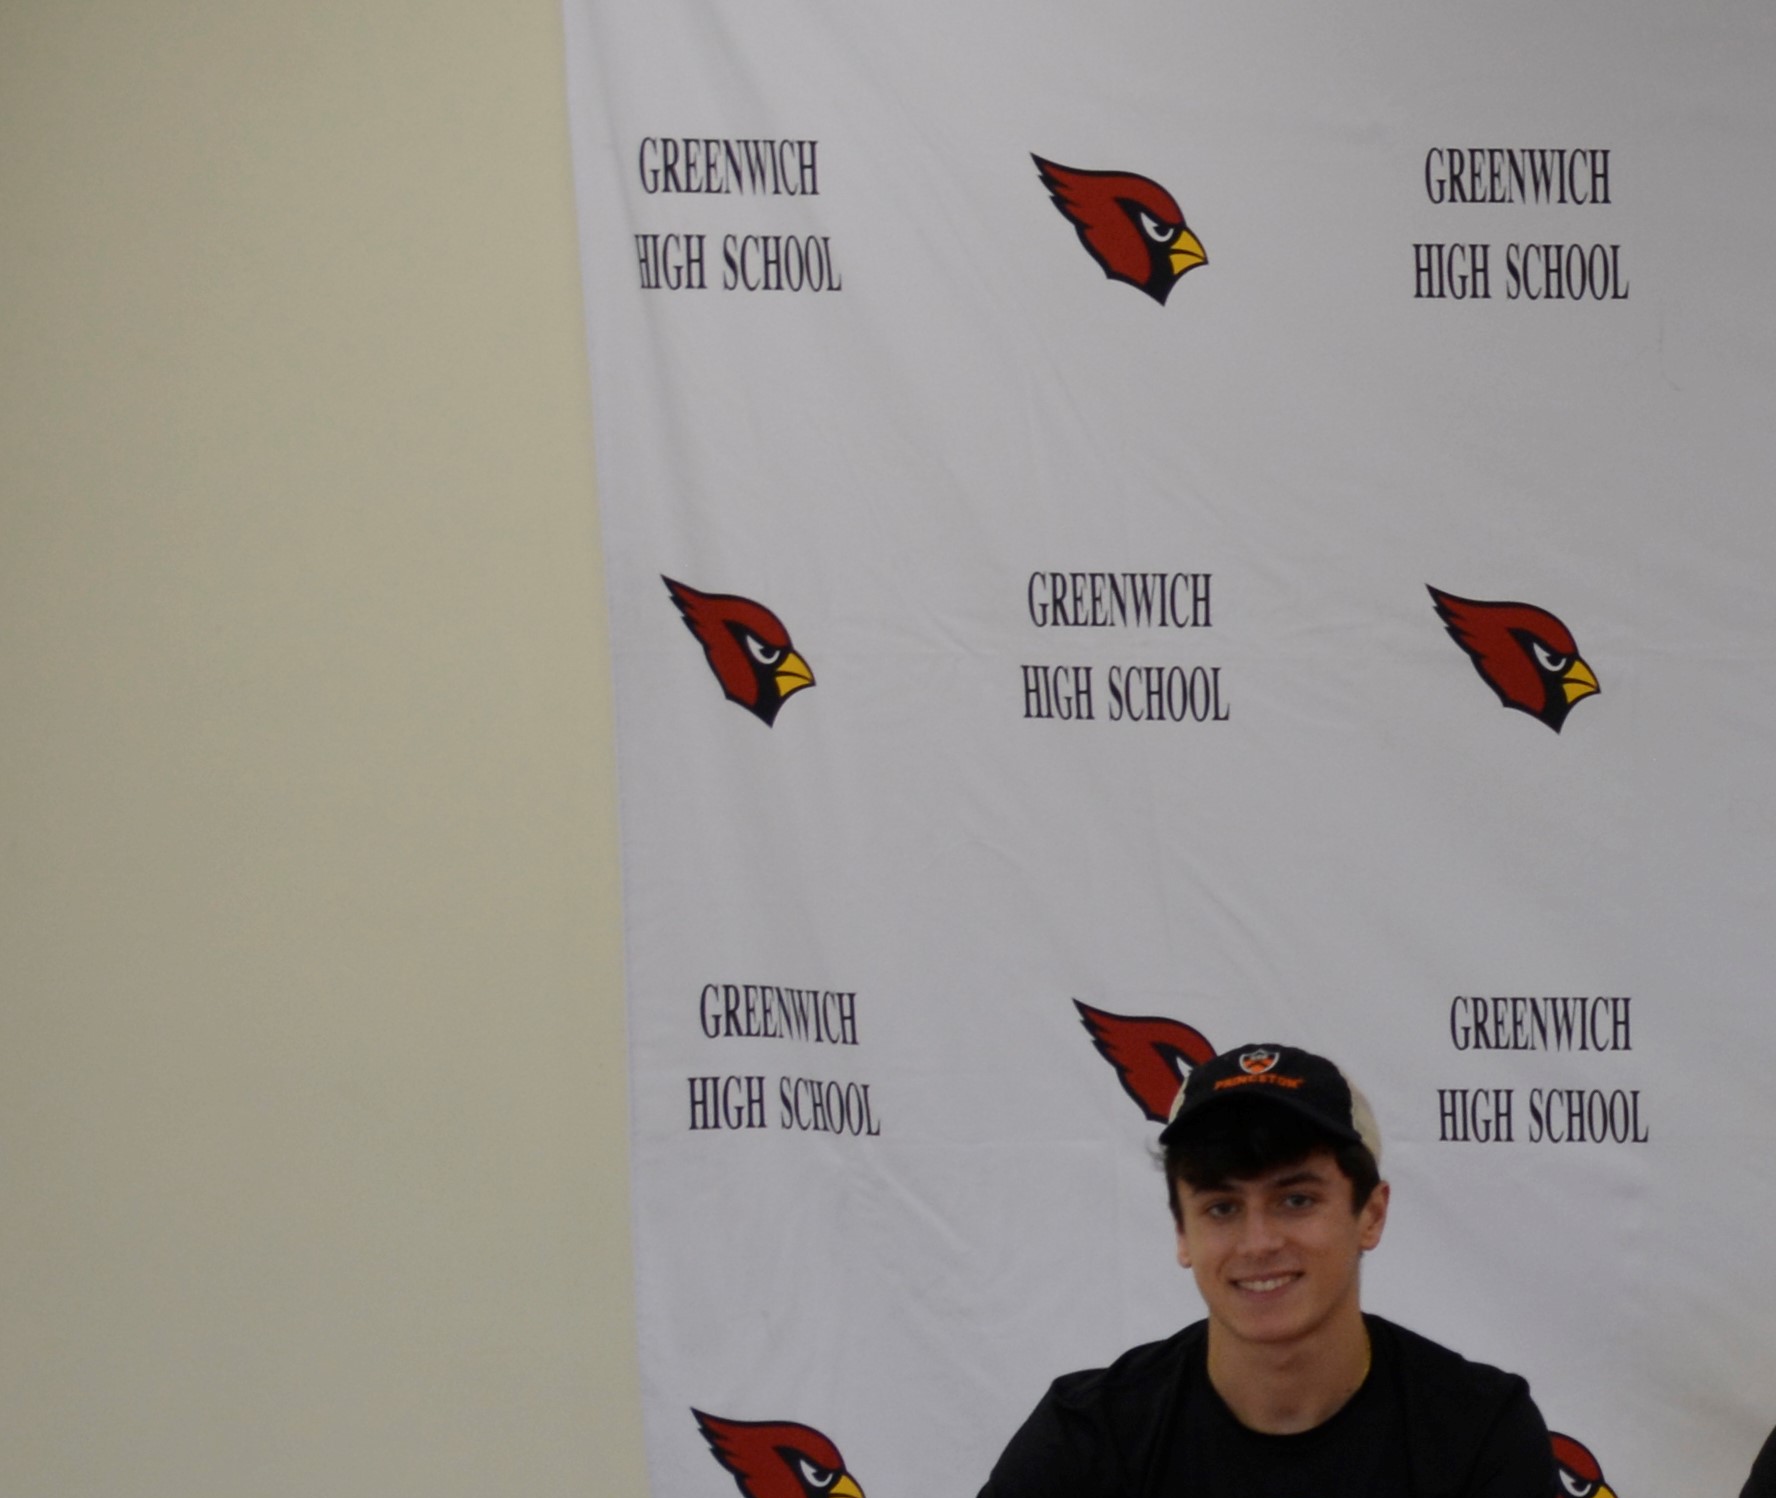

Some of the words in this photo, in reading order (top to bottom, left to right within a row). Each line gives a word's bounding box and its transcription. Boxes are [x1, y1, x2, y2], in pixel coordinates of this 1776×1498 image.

[639, 137, 819, 196] GREENWICH
[1425, 148, 1611, 205] GREENWICH
[635, 234, 706, 290] HIGH
[723, 234, 841, 292] SCHOOL
[1413, 243, 1491, 299] HIGH
[1507, 243, 1628, 300] SCHOOL
[1028, 572, 1211, 628] GREENWICH
[1021, 665, 1094, 720] HIGH
[1109, 666, 1229, 722] SCHOOL
[700, 984, 858, 1045] GREENWICH
[1451, 996, 1631, 1051] GREENWICH
[688, 1076, 766, 1130] HIGH
[780, 1077, 880, 1136] SCHOOL
[1438, 1089, 1514, 1143] HIGH
[1530, 1088, 1648, 1143] SCHOOL
